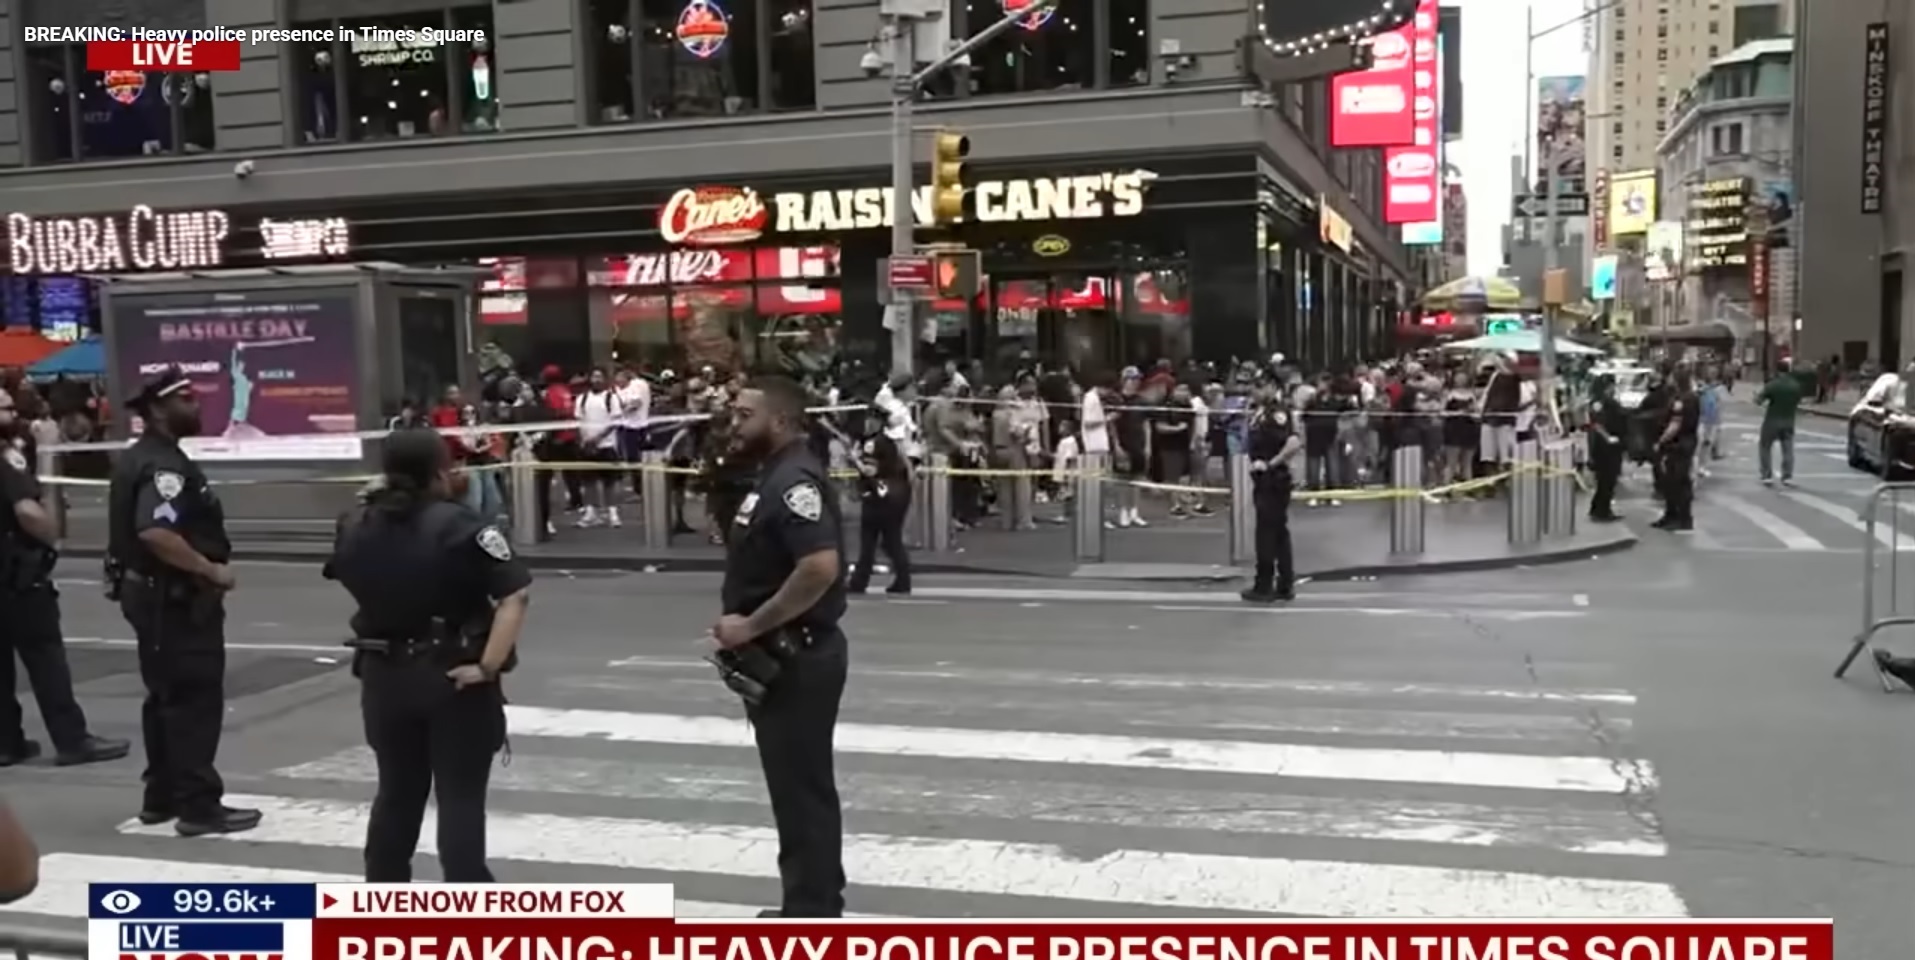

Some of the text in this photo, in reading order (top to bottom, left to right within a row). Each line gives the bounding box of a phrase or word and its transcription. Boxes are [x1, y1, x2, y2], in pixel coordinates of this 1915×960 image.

[1863, 127, 1881, 212] THEATRE
[9, 212, 125, 274] BUBBA
[129, 205, 228, 269] GUMP
[660, 186, 765, 243] Cane's
[974, 172, 1141, 223] CANE'S
[159, 316, 309, 342] BASTILLE DAY
